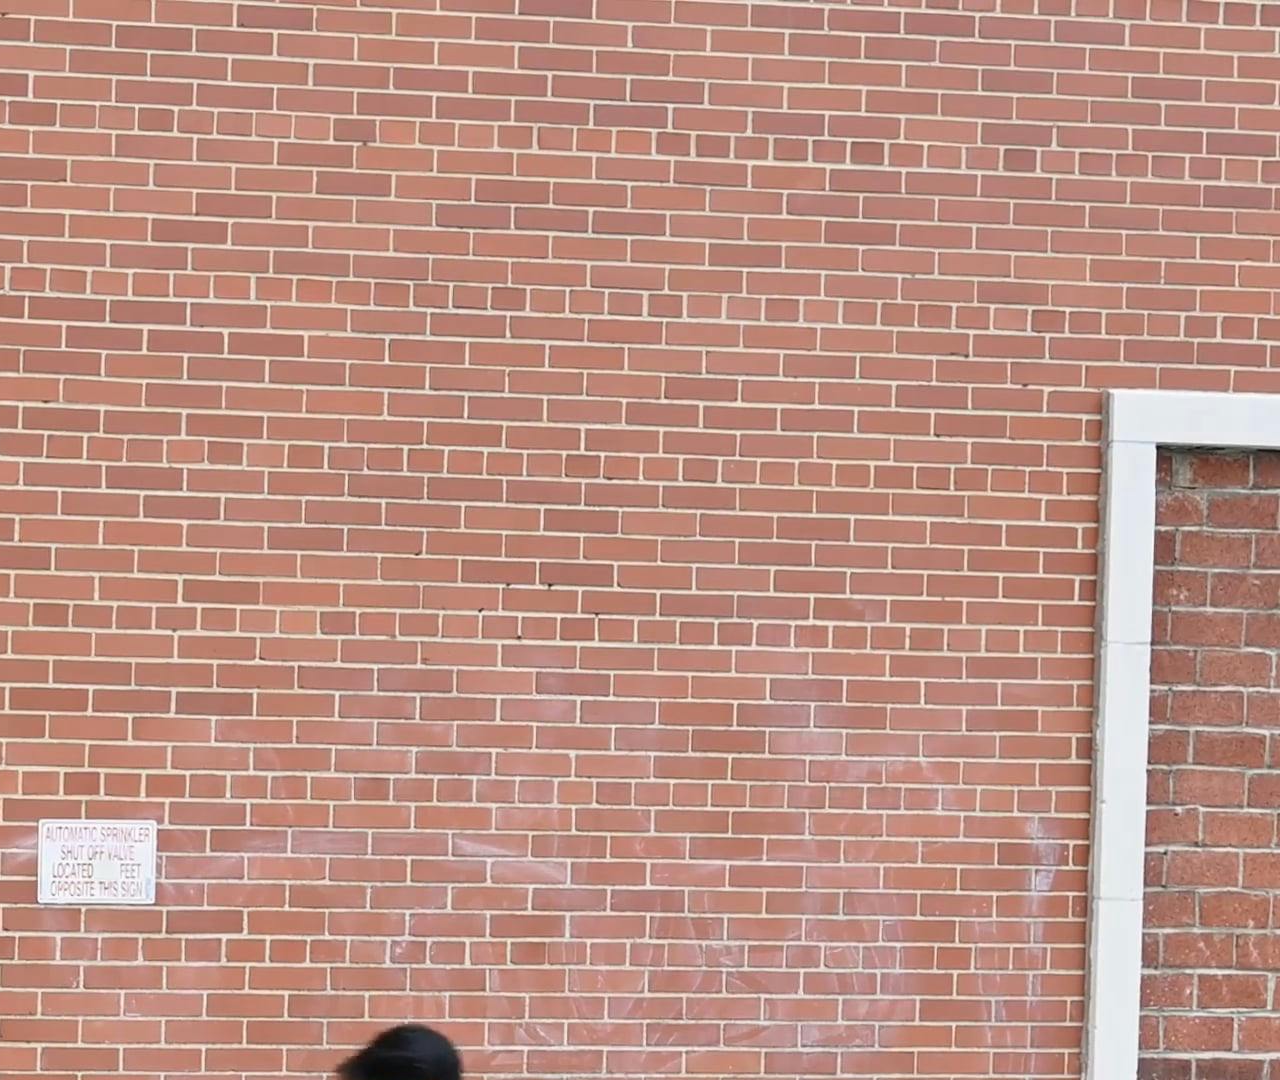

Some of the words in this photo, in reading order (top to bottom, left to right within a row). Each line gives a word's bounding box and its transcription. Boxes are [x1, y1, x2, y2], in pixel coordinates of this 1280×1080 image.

[46, 826, 97, 842] AUTOMATIC
[101, 826, 150, 842] SPRINKLER
[61, 844, 85, 860] SHUT
[88, 844, 104, 860] OFF
[107, 845, 135, 861] VALVE
[52, 862, 94, 878] LOCATED
[120, 863, 142, 879] FEET
[51, 880, 95, 896] OPPOSITE
[98, 881, 118, 897] THIS
[121, 881, 143, 897] SIGN
